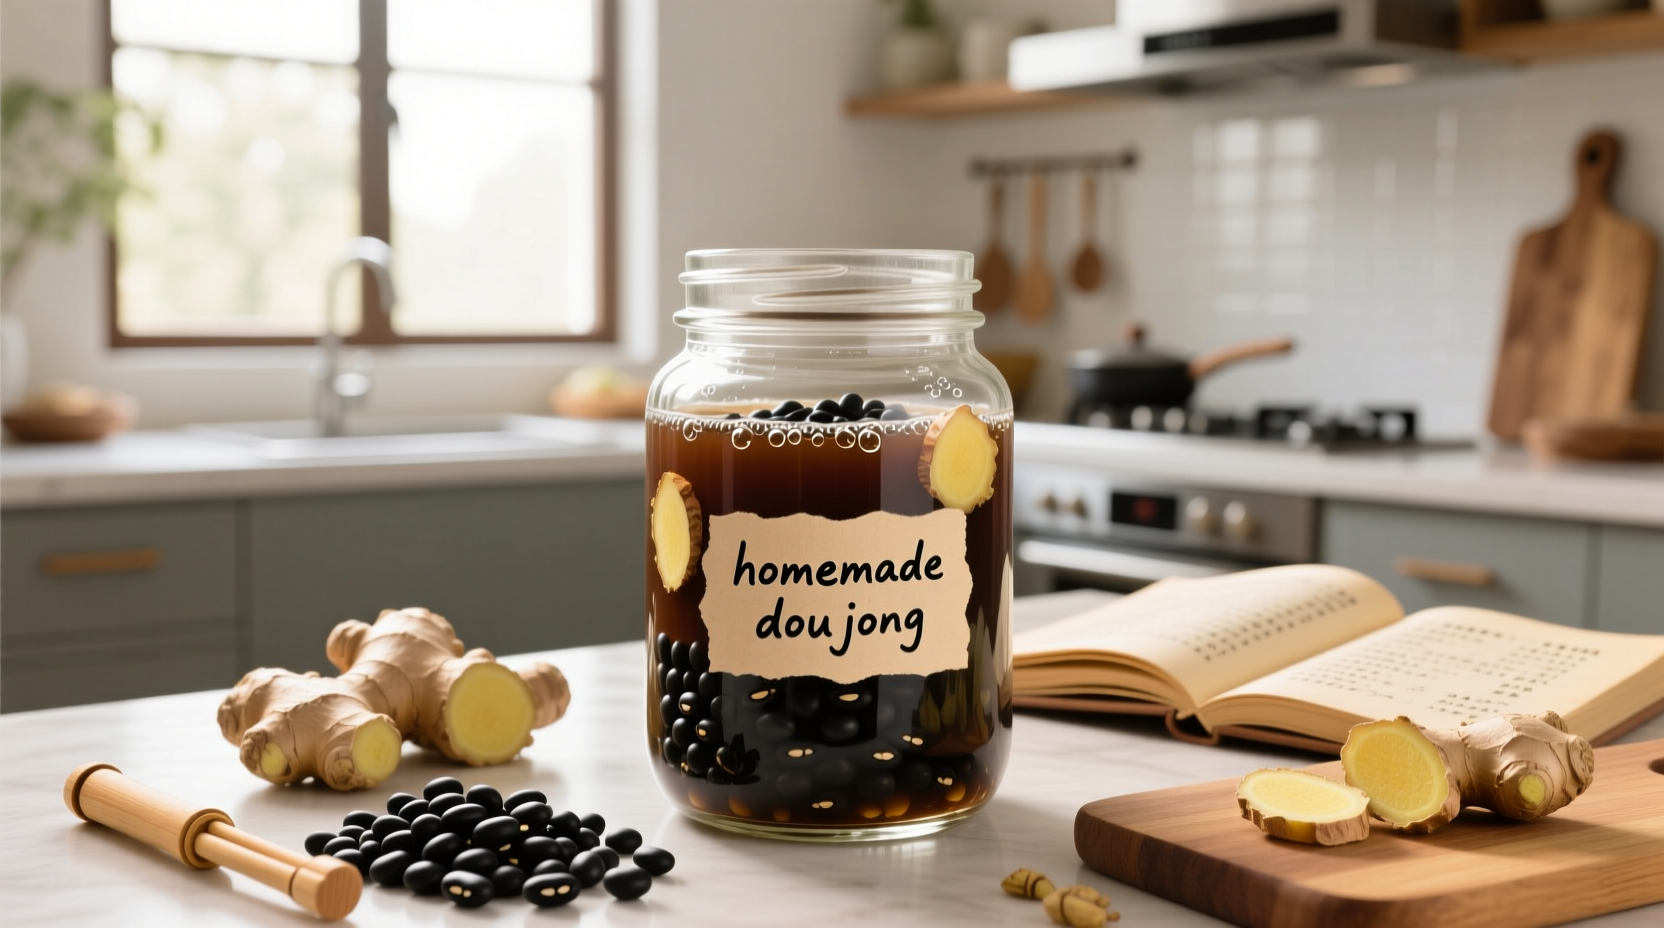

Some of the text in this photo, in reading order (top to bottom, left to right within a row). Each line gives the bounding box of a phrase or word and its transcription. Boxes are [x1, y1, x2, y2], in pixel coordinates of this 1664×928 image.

[733, 538, 944, 587] homemade
[755, 596, 924, 657] dou jong
